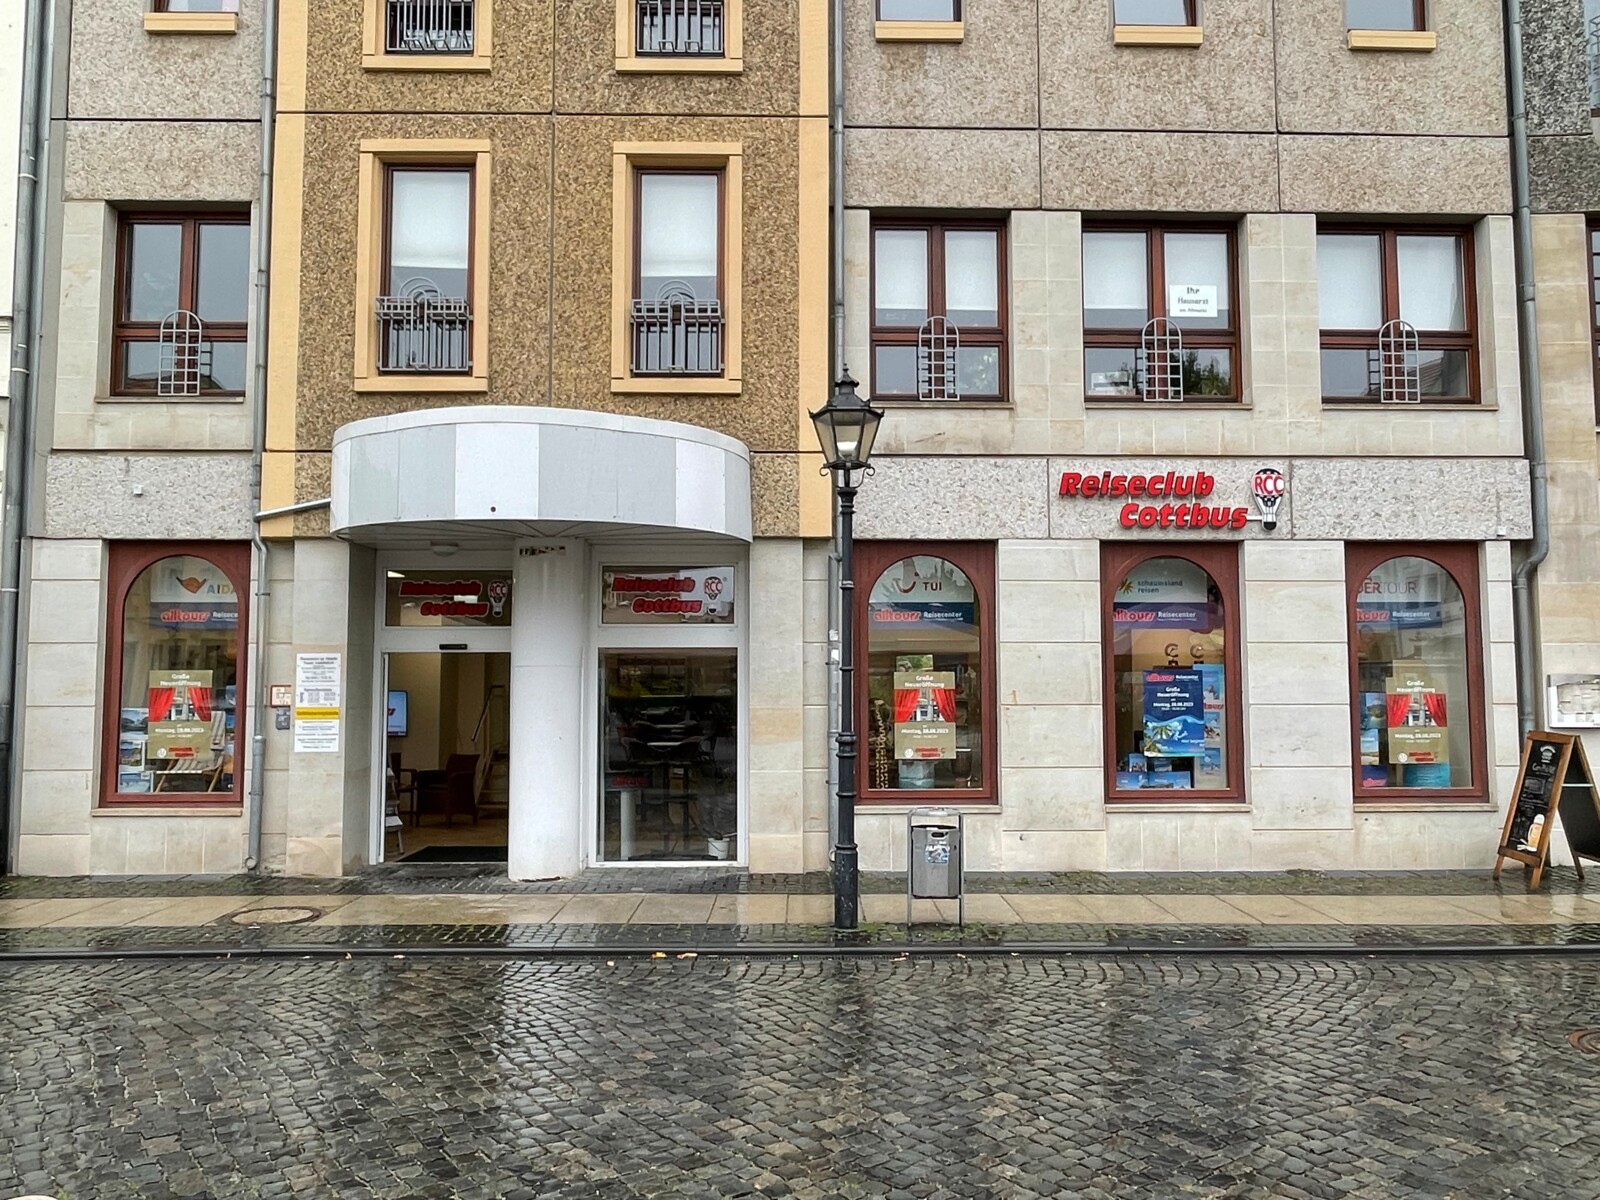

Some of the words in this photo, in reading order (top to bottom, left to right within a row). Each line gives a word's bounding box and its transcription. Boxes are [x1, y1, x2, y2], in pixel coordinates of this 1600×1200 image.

[1186, 286, 1200, 294] Ihr
[1058, 470, 1215, 497] Reiseclub
[1254, 474, 1284, 495] RCC
[1119, 502, 1249, 530] Cottbus
[490, 582, 508, 598] RCC
[612, 576, 696, 593] Reiseclub
[705, 580, 723, 595] RCC
[922, 581, 942, 592] TUI
[1137, 579, 1183, 588] schauinsland
[420, 601, 489, 617] Cottbus
[632, 597, 703, 614] Cottbus
[161, 609, 210, 623] alltours
[873, 608, 921, 622] alltours
[923, 611, 963, 619] Reisecenter
[1157, 611, 1197, 619] Reisecenter
[1392, 611, 1431, 619] Reisecenter
